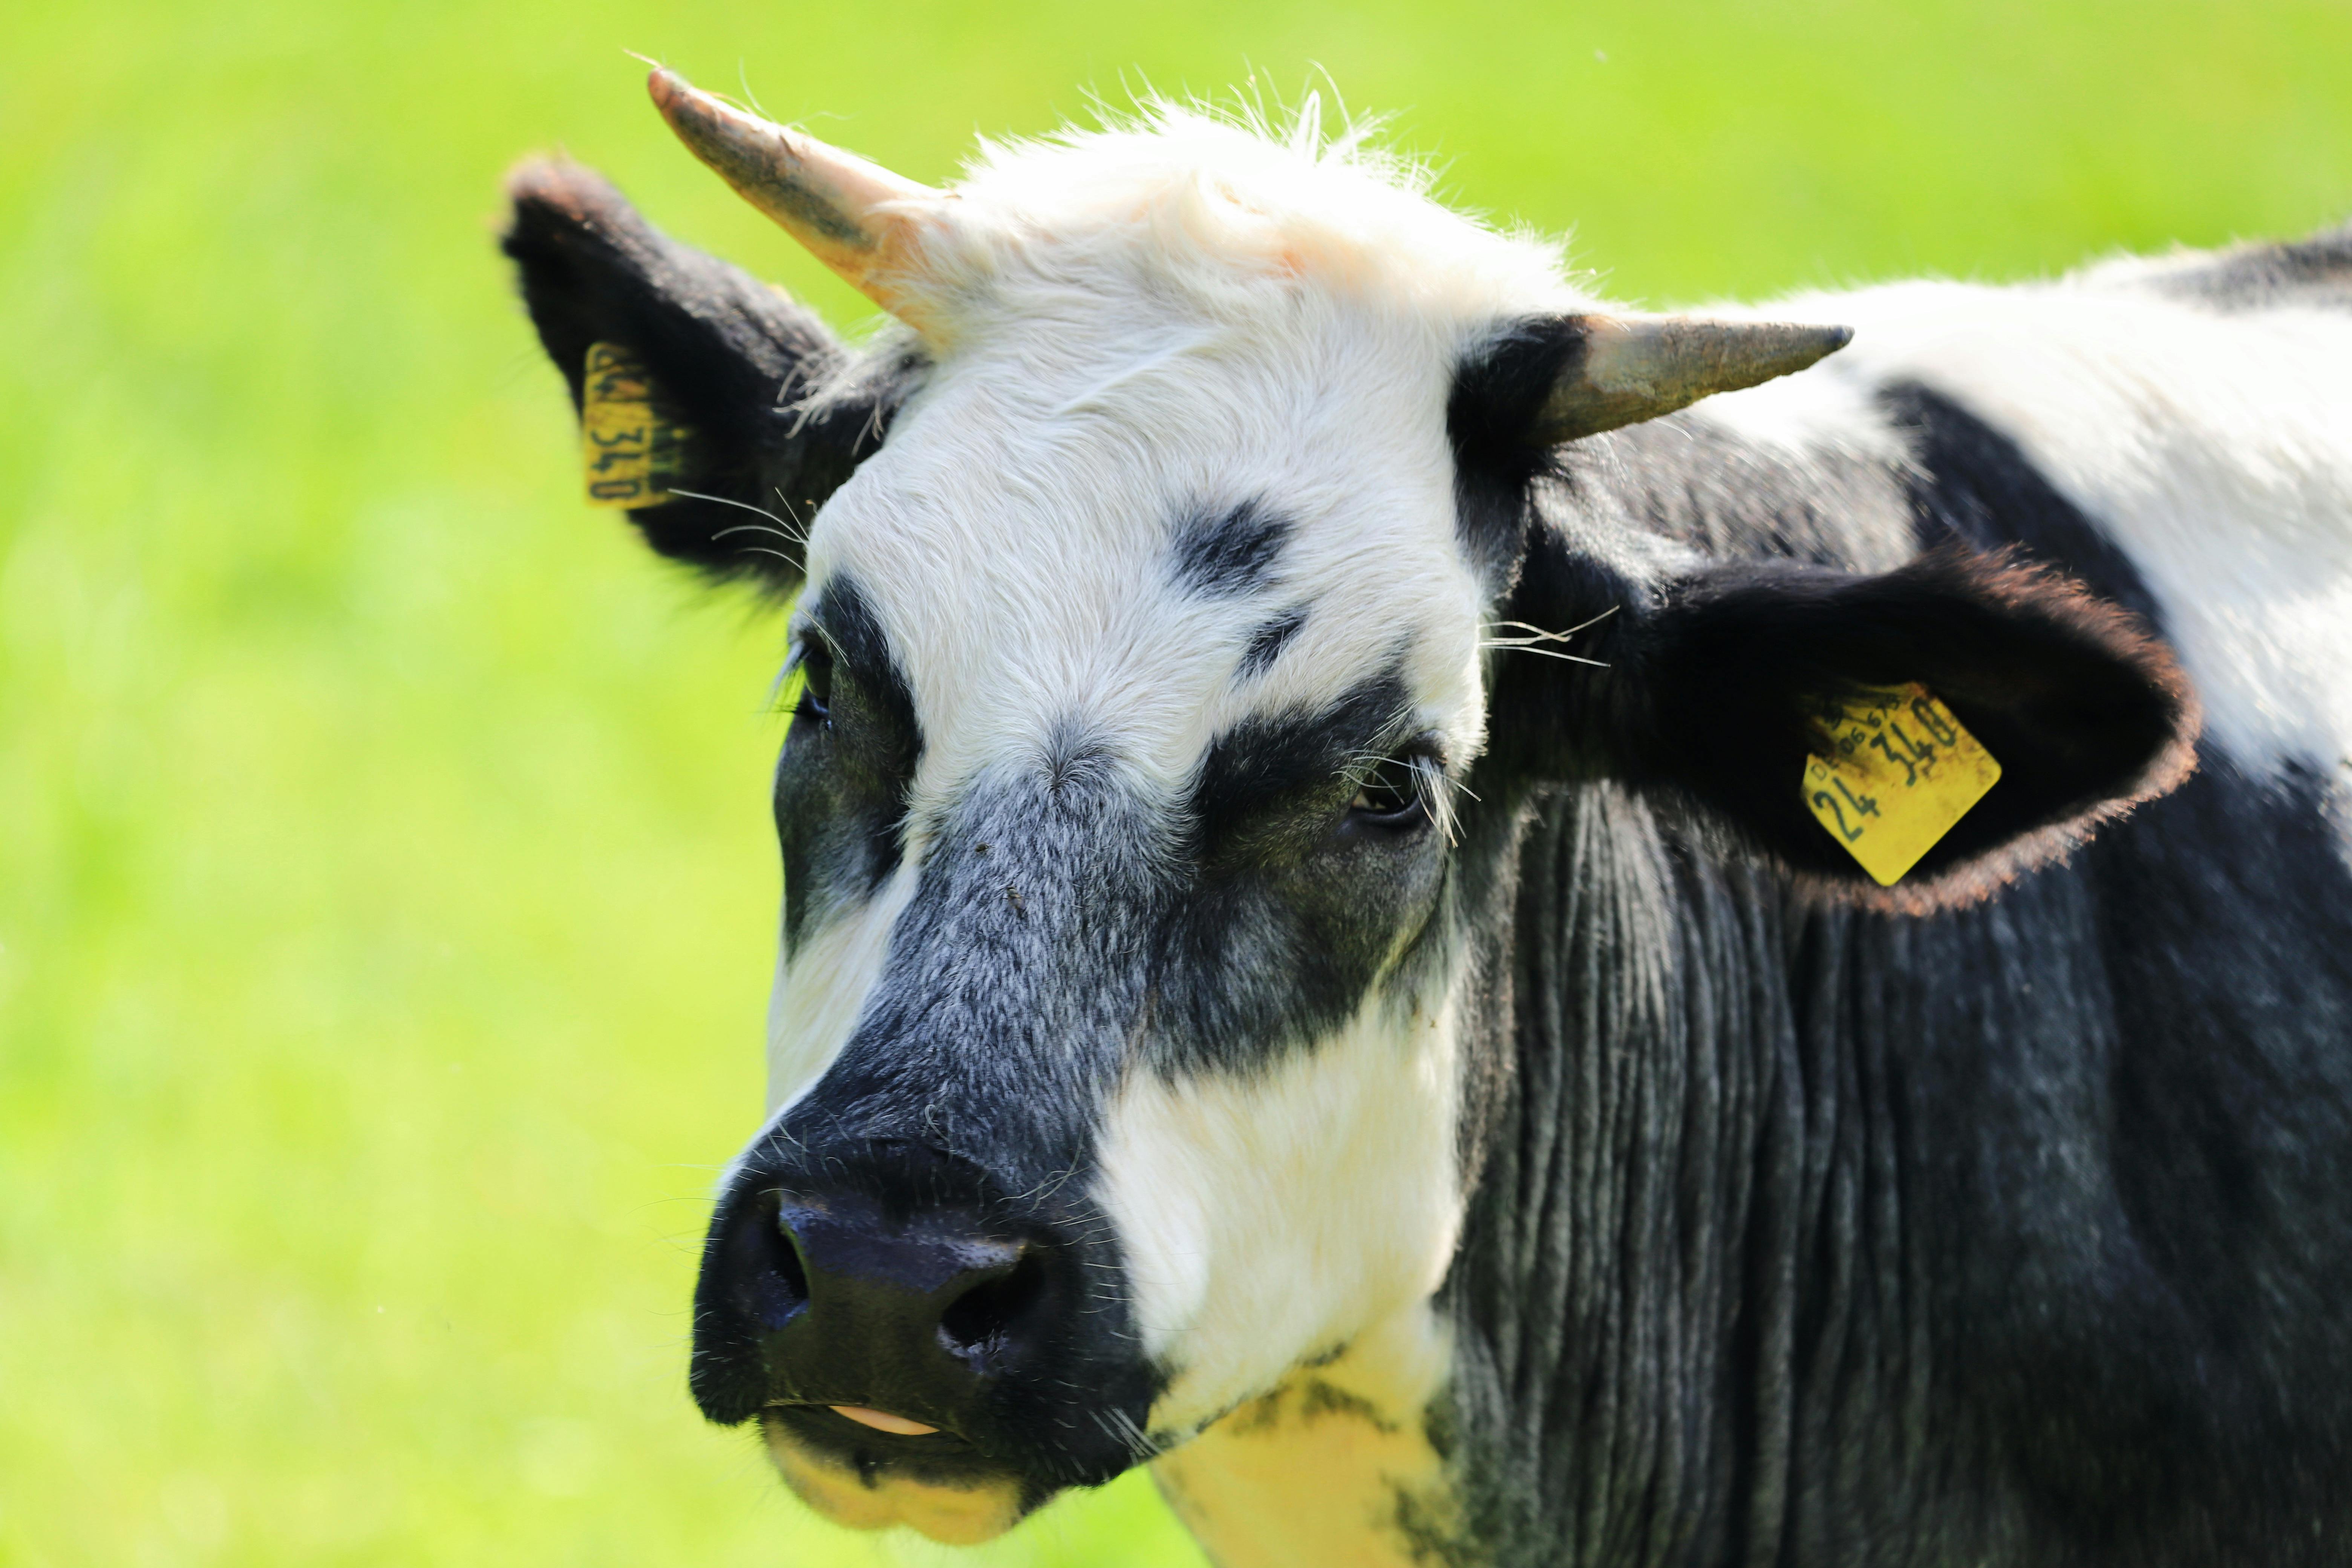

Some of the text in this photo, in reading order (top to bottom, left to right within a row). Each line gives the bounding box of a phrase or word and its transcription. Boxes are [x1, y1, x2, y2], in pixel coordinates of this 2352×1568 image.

[590, 426, 644, 500] 340
[1813, 697, 1956, 843] 24 340
[1839, 726, 1866, 755] 06
